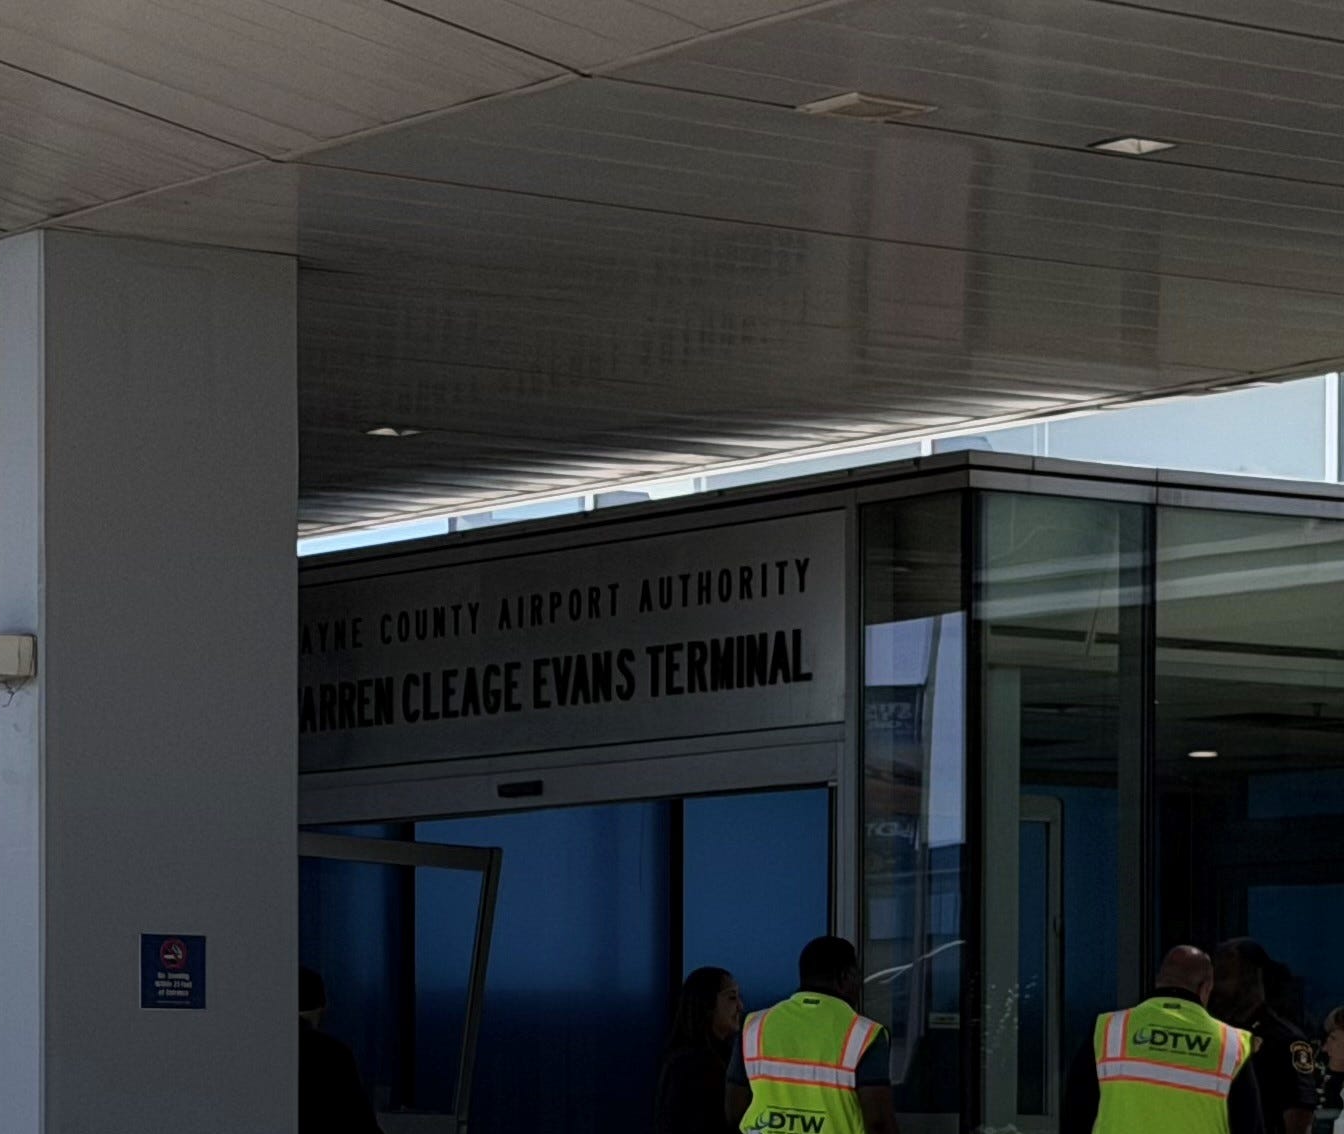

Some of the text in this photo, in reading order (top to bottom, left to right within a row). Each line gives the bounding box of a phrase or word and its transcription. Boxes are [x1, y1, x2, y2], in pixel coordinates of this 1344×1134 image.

[299, 557, 810, 656] AYNE COUNTY AIRPORT AUTHORITY
[298, 628, 814, 734] ARREN CLEAGE EVANS TERMINAL
[1149, 1029, 1213, 1053] DTW
[768, 1111, 826, 1134] DTW
